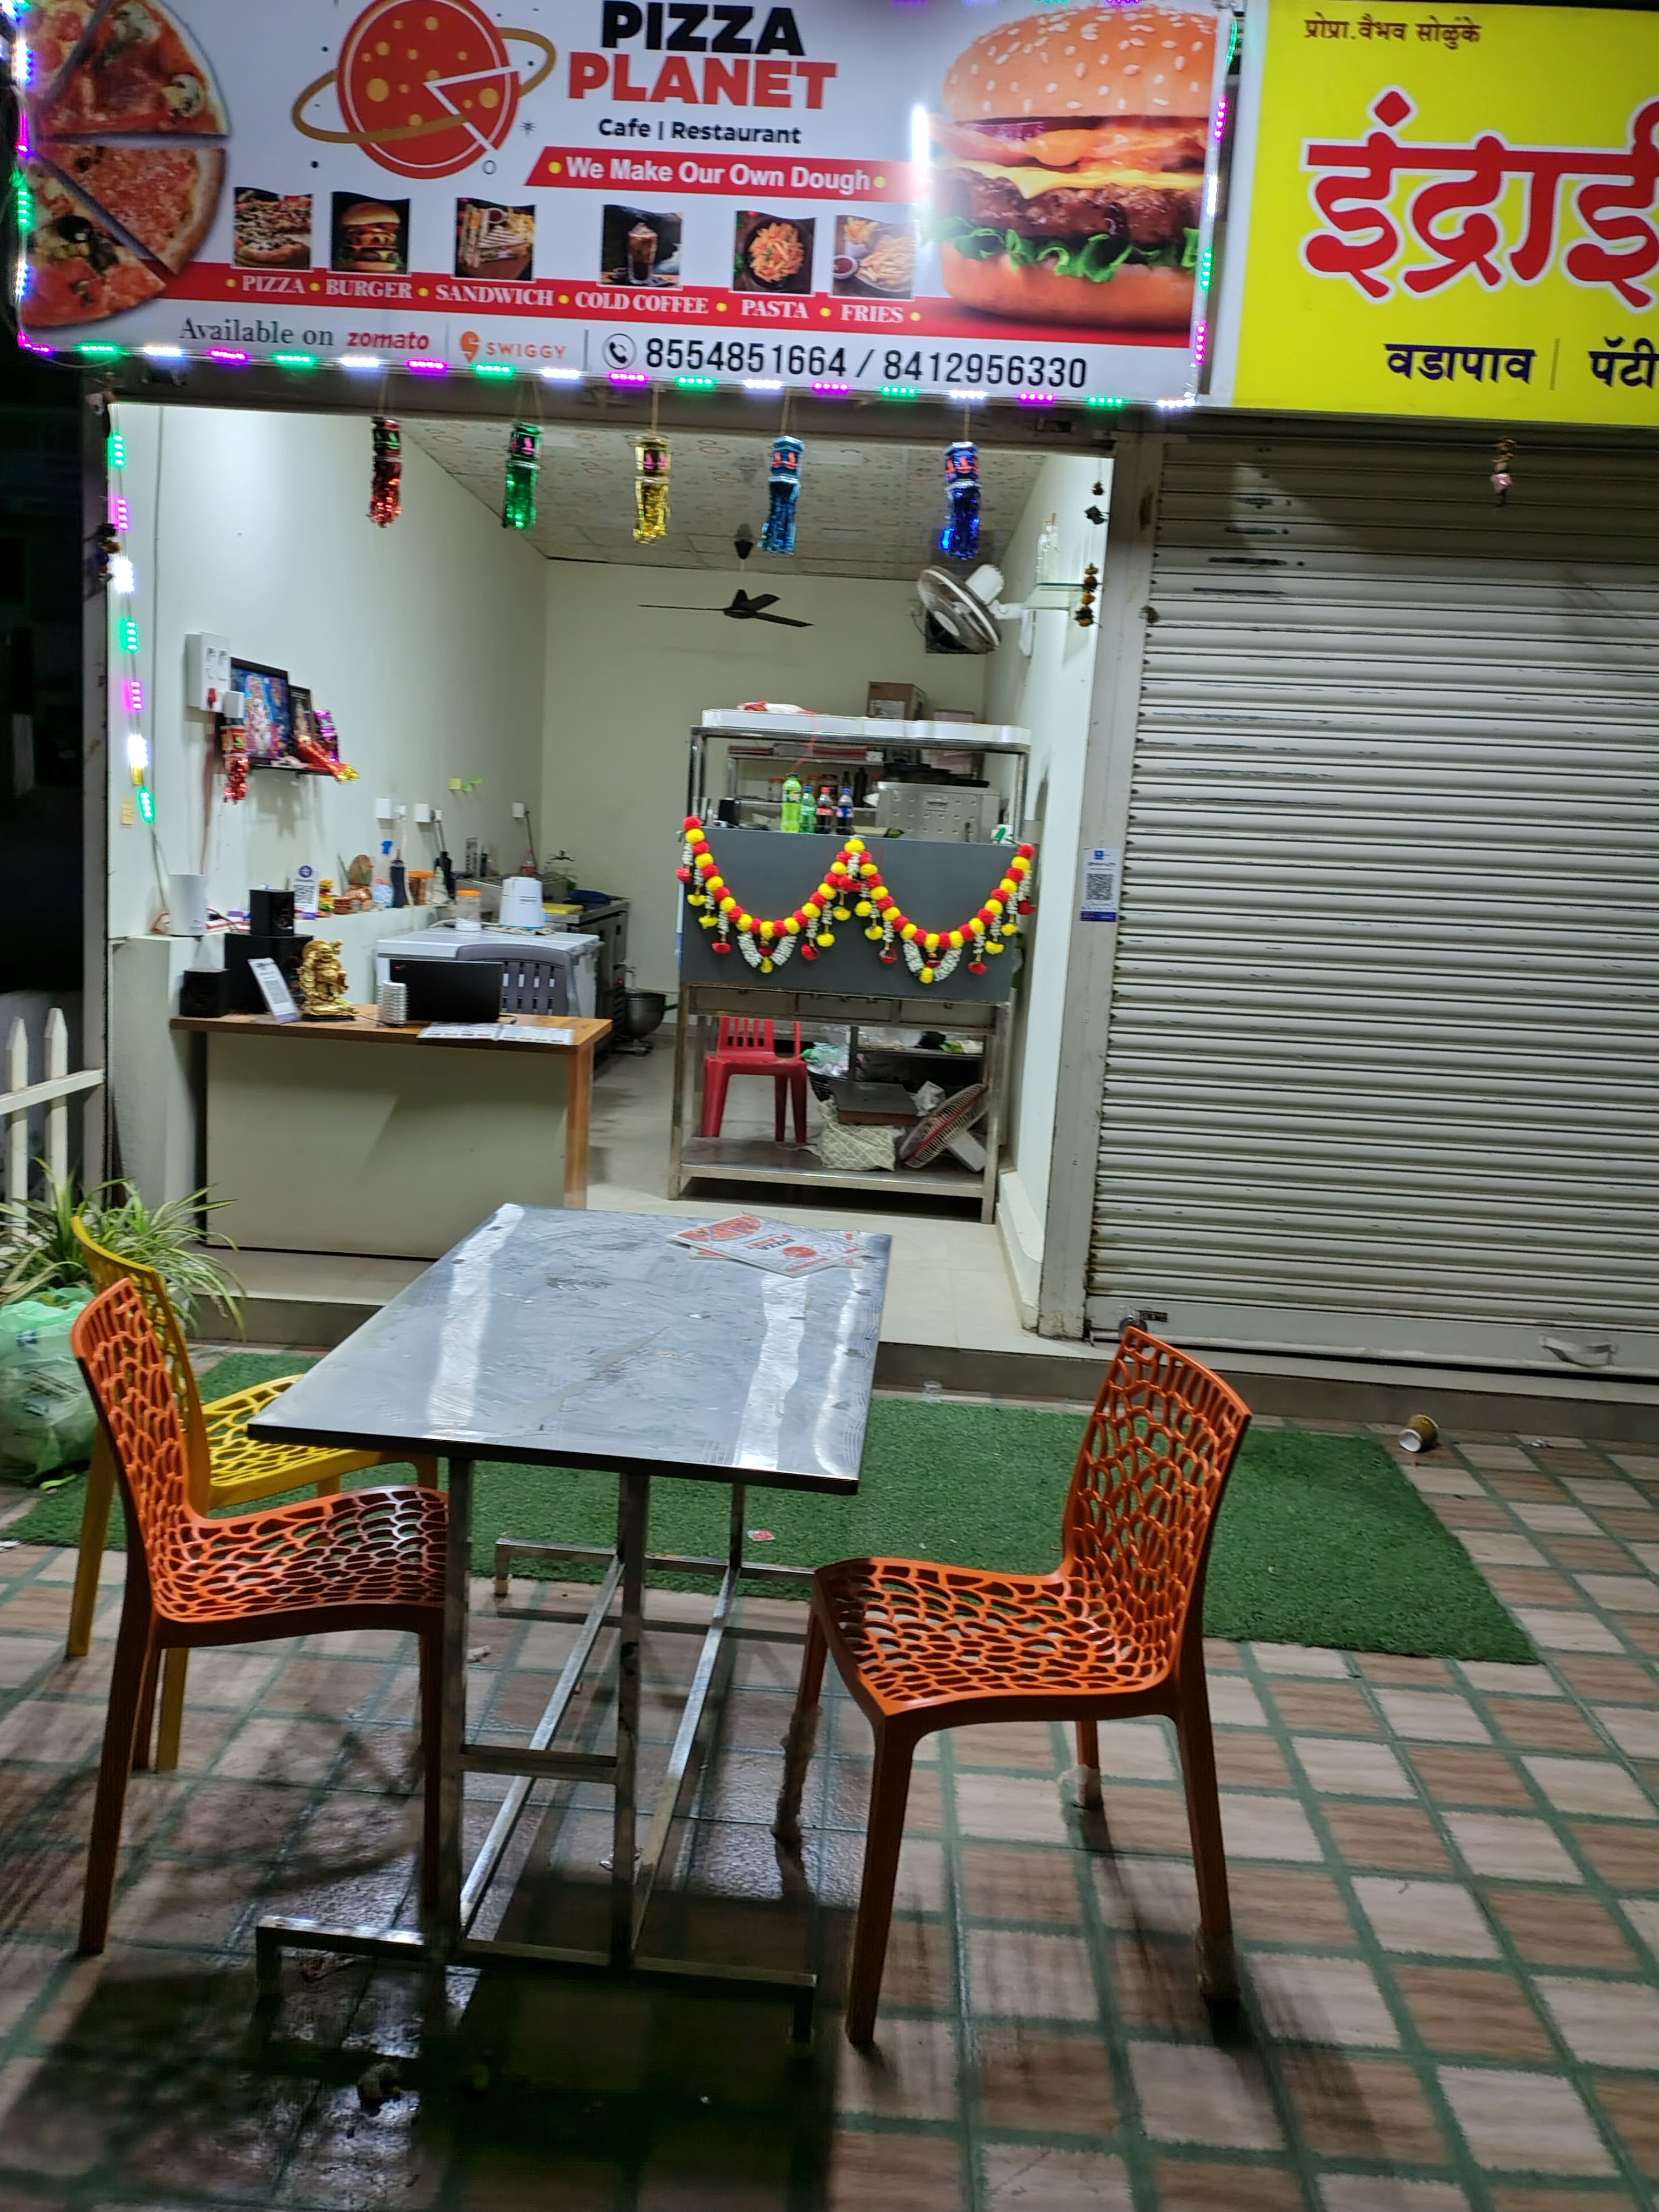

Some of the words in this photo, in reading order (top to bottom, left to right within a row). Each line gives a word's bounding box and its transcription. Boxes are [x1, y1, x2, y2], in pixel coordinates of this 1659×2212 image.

[601, 1, 806, 56] PIZZA
[568, 52, 839, 110] PLANET
[598, 118, 652, 138] Cafe
[671, 121, 802, 145] Restaurant
[565, 156, 604, 180] We
[610, 158, 673, 183] Make
[679, 162, 725, 185] Our
[730, 165, 784, 187] Own
[791, 166, 871, 195] Dough
[242, 275, 306, 295] PIZZA
[326, 278, 413, 299] BURGER
[435, 284, 554, 308] SANDWICH
[575, 291, 631, 311] COLD
[632, 295, 710, 314] COFFEE
[741, 299, 810, 319] PASTA
[841, 304, 904, 323] FRIES
[179, 318, 292, 346] Available
[302, 331, 334, 346] on
[347, 331, 429, 350] zomato
[487, 342, 567, 359] SWIGGY
[647, 337, 847, 377] 8554851664
[884, 349, 1088, 388] 8412956330
[1383, 343, 1537, 385] वडापाव
[1587, 336, 1659, 389] पॅटी
